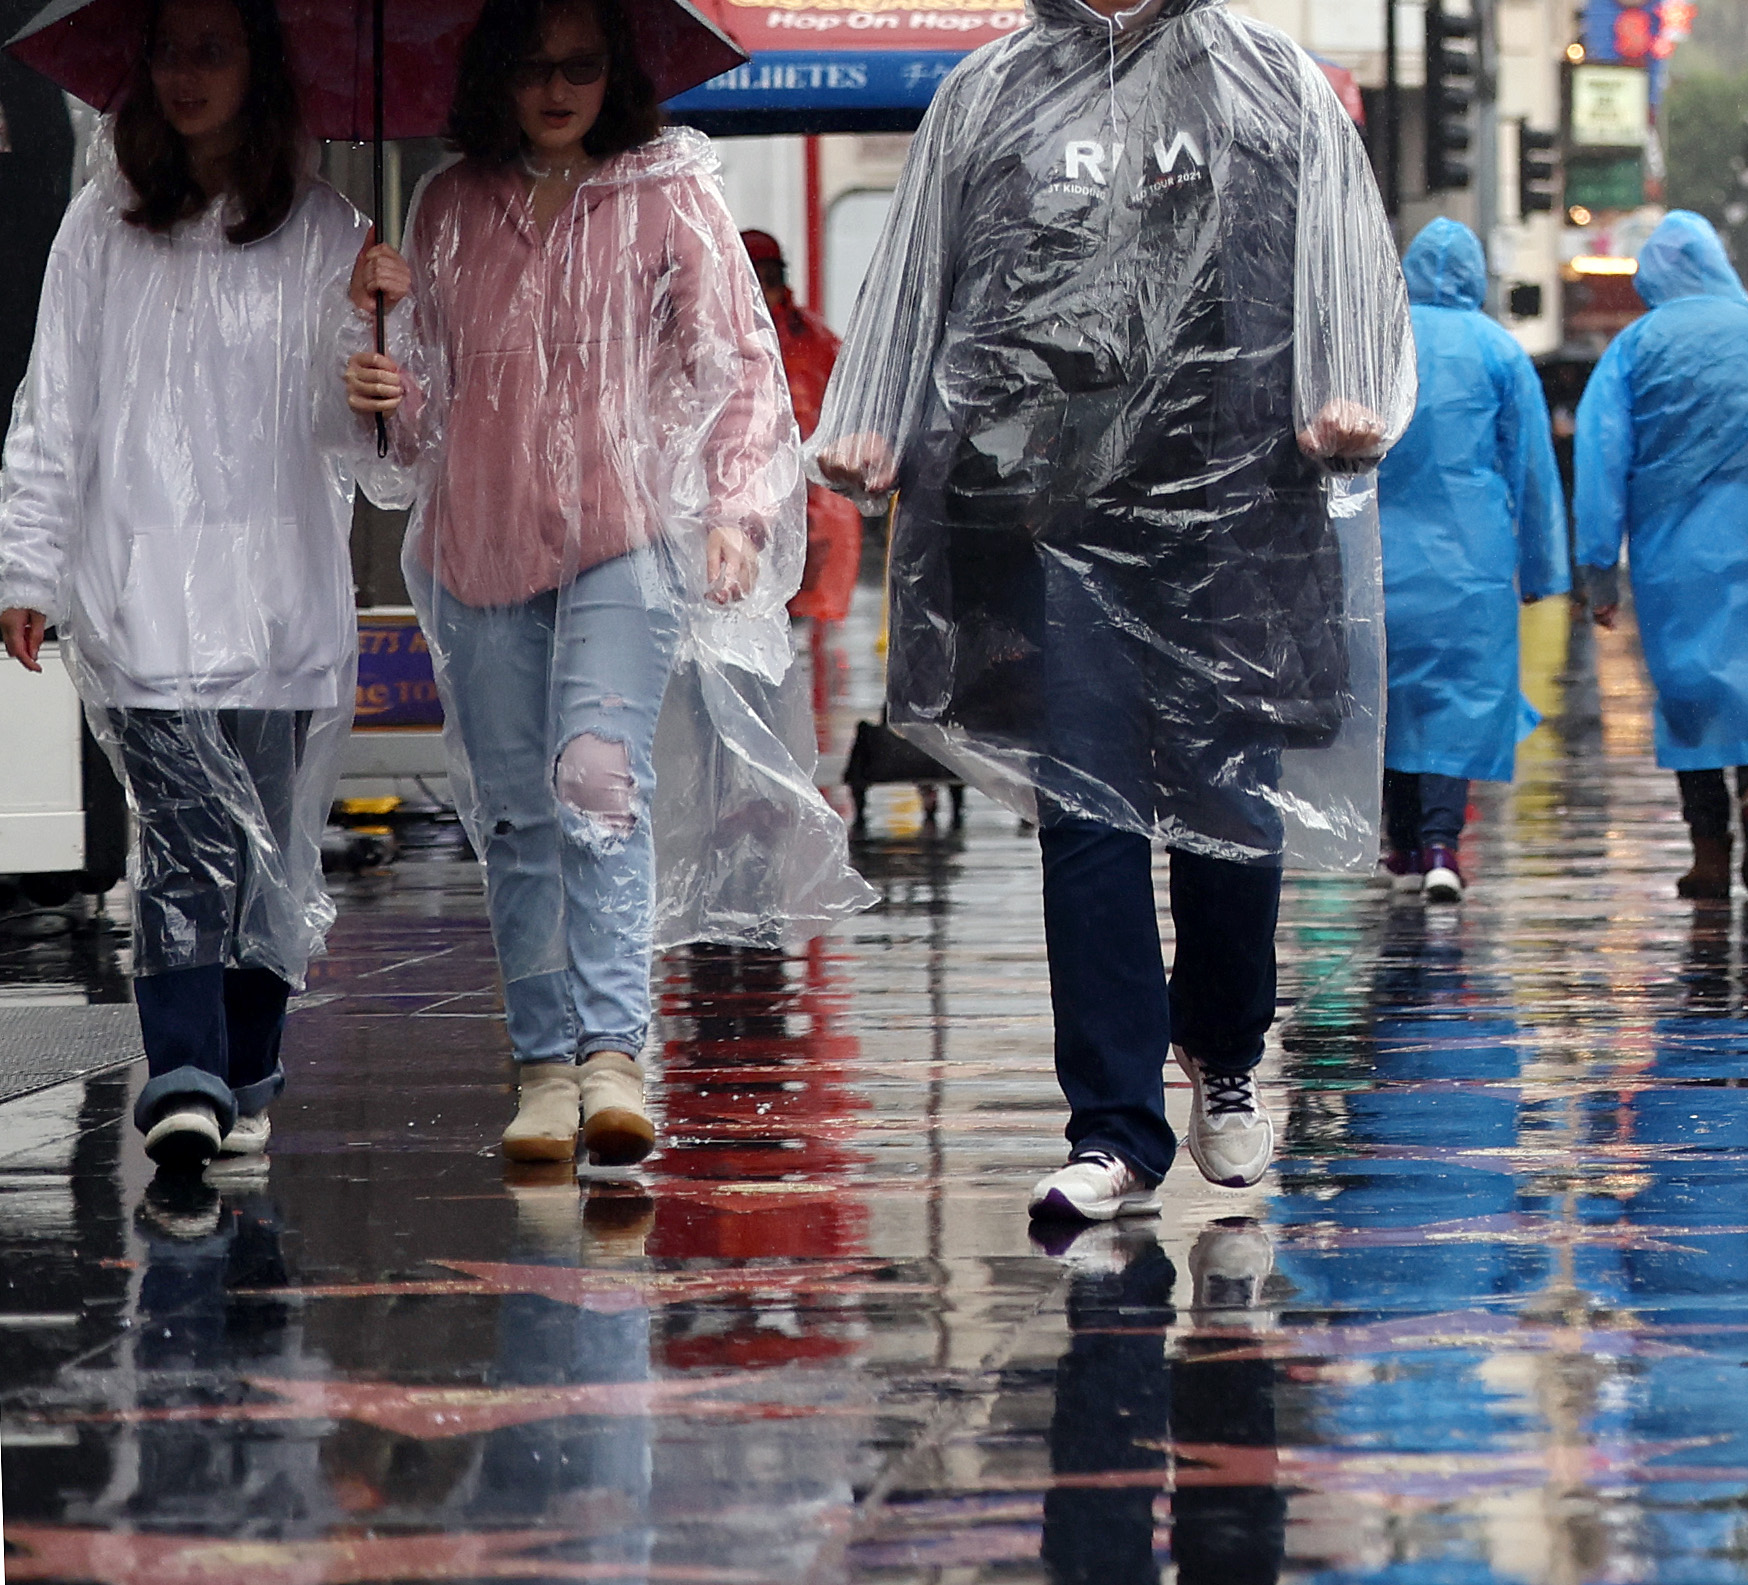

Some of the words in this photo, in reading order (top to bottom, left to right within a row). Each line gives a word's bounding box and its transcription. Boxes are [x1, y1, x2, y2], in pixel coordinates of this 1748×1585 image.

[766, 11, 842, 32] Hop
[846, 11, 901, 30] On
[908, 11, 983, 32] Hop
[1063, 183, 1107, 201] KIDDING
[1149, 176, 1175, 192] TOUR
[1177, 171, 1203, 183] 2021
